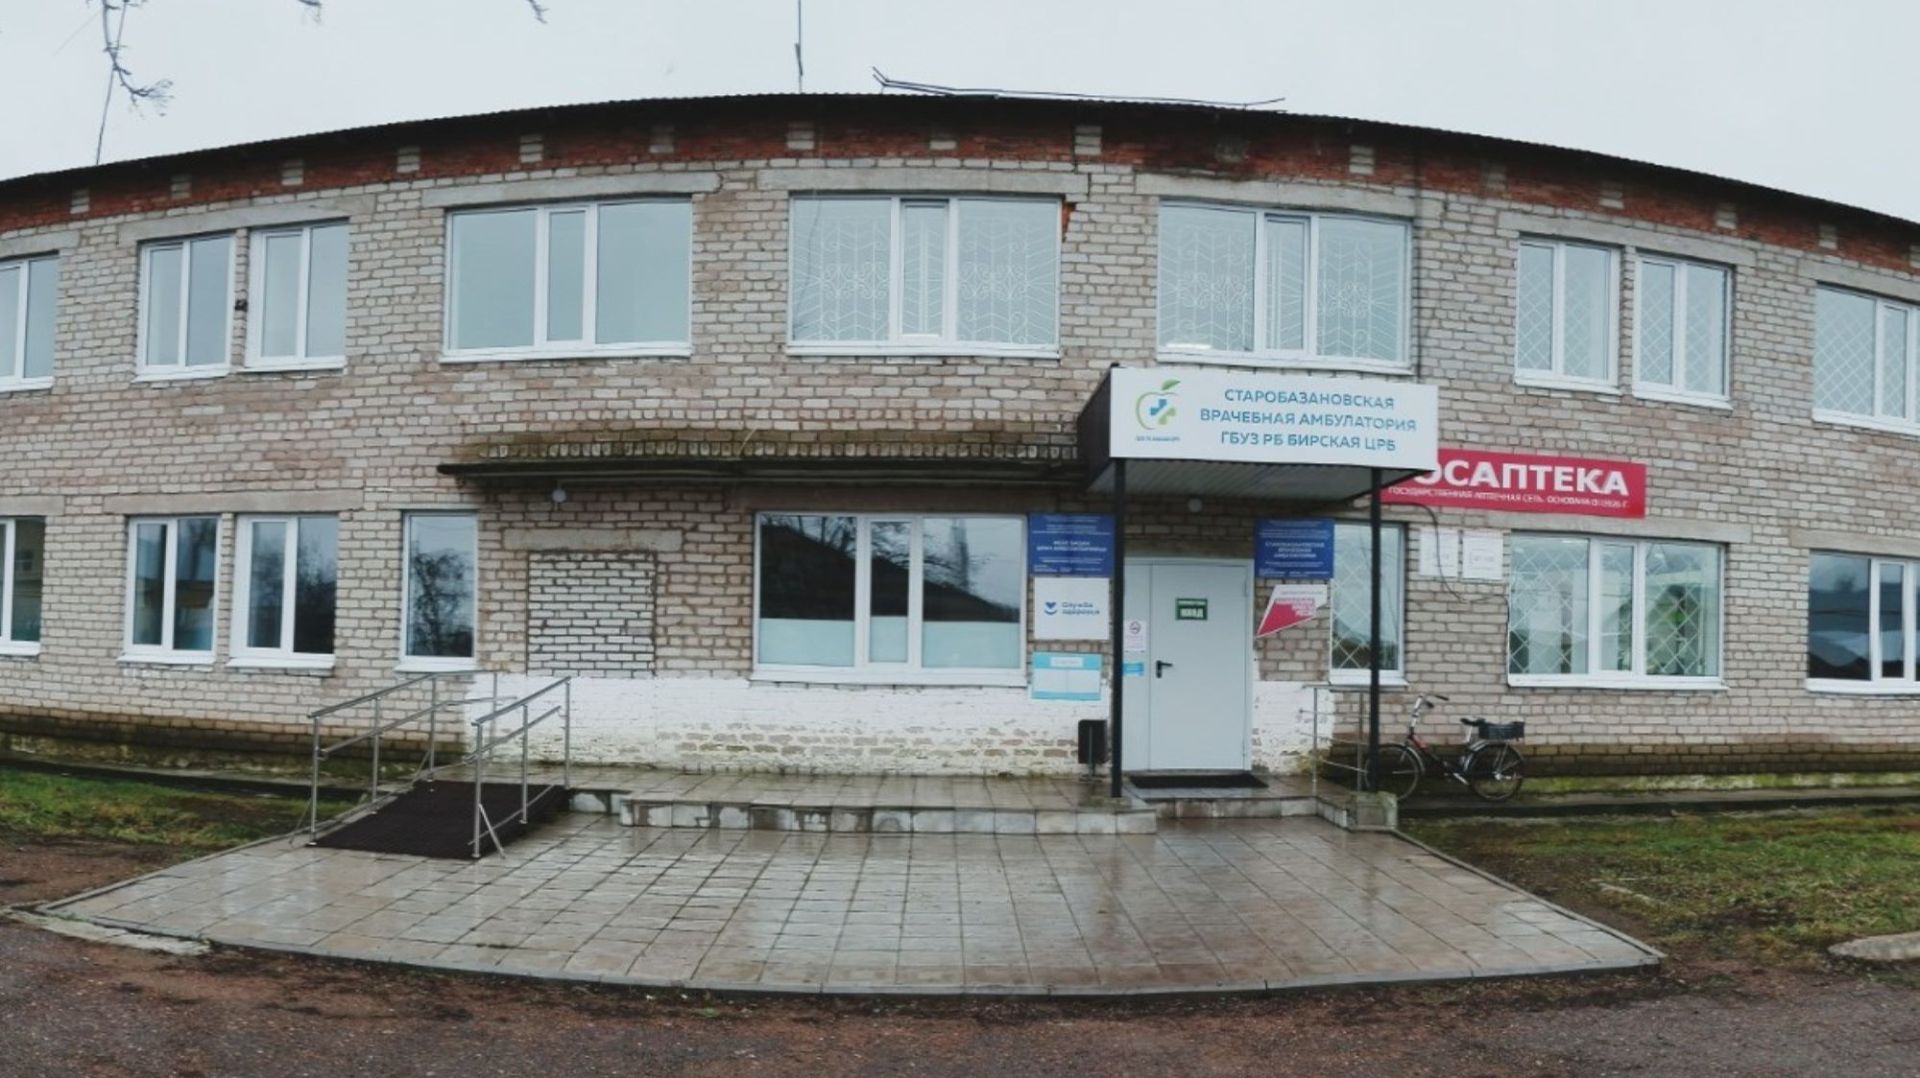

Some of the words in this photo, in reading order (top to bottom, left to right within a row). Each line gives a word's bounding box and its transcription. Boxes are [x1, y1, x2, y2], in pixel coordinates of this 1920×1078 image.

[1224, 389, 1395, 409] СТАРОБАЗАНОВСКАЯ
[1200, 408, 1296, 425] ВРАЧЕБНАЯ
[1299, 413, 1417, 431] АМБУЛАТОРИЯ
[1220, 431, 1259, 446] ГБУЗ
[1263, 434, 1284, 447] РБ
[1287, 434, 1361, 449] БИРСКАЯ
[1365, 437, 1396, 452] ЦРБ
[1413, 459, 1630, 496] ОСАПТЕКА
